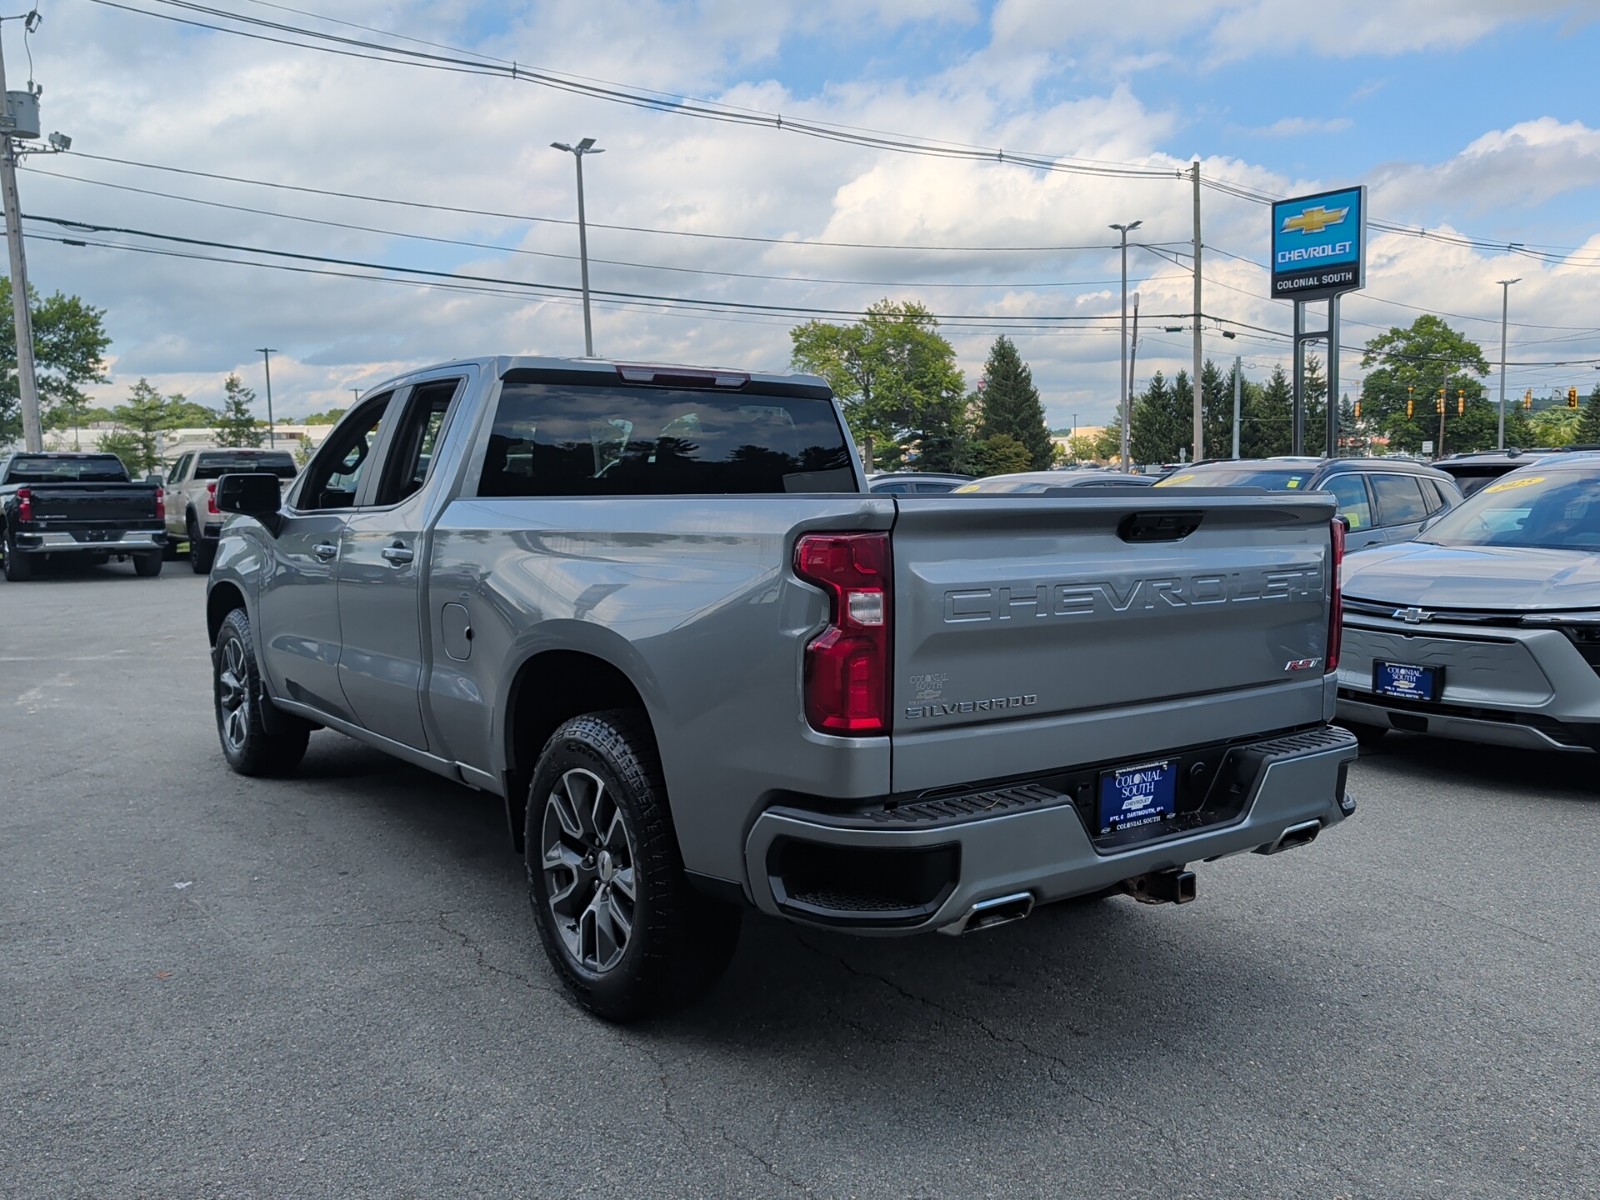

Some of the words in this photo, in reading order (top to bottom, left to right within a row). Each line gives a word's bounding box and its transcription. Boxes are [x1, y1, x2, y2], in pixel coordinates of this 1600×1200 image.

[1277, 241, 1352, 263] CHEVROLET
[1277, 277, 1319, 290] COLONIAL
[1322, 272, 1353, 284] SOUTH
[944, 567, 1318, 623] CHEVROLET
[1284, 657, 1322, 671] RST
[910, 673, 949, 684] COLONIAL
[1387, 667, 1422, 677] COLONIAL
[1392, 673, 1416, 682] SOUTH
[915, 682, 942, 690] SOUTH
[905, 694, 1037, 719] SILVERADO
[1116, 770, 1162, 788] COLONIAL
[1122, 782, 1154, 798] SOUTH
[1116, 820, 1142, 831] COLONIAL
[1143, 816, 1161, 825] SOUTH
